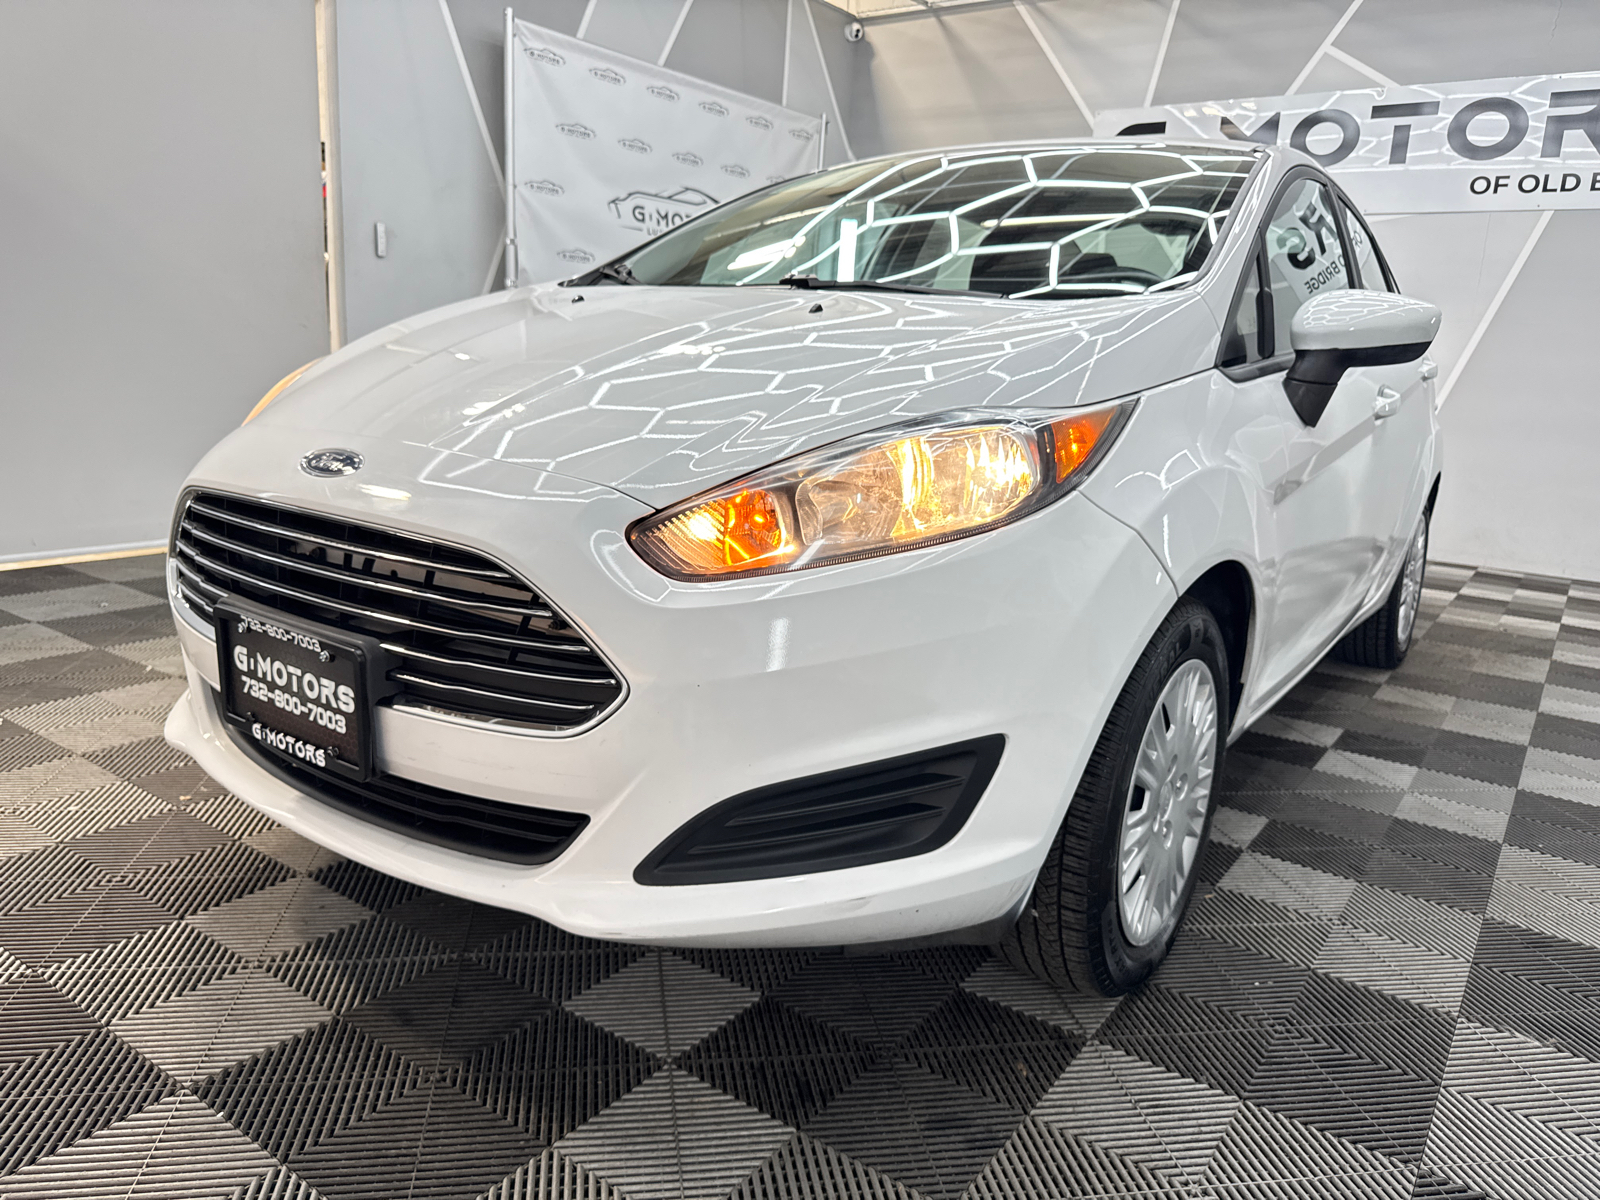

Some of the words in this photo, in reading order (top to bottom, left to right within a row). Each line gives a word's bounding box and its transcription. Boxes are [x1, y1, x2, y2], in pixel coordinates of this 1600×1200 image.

[1469, 174, 1511, 195] OF
[1517, 172, 1582, 194] OLD
[241, 675, 347, 735] 732-800-7003
